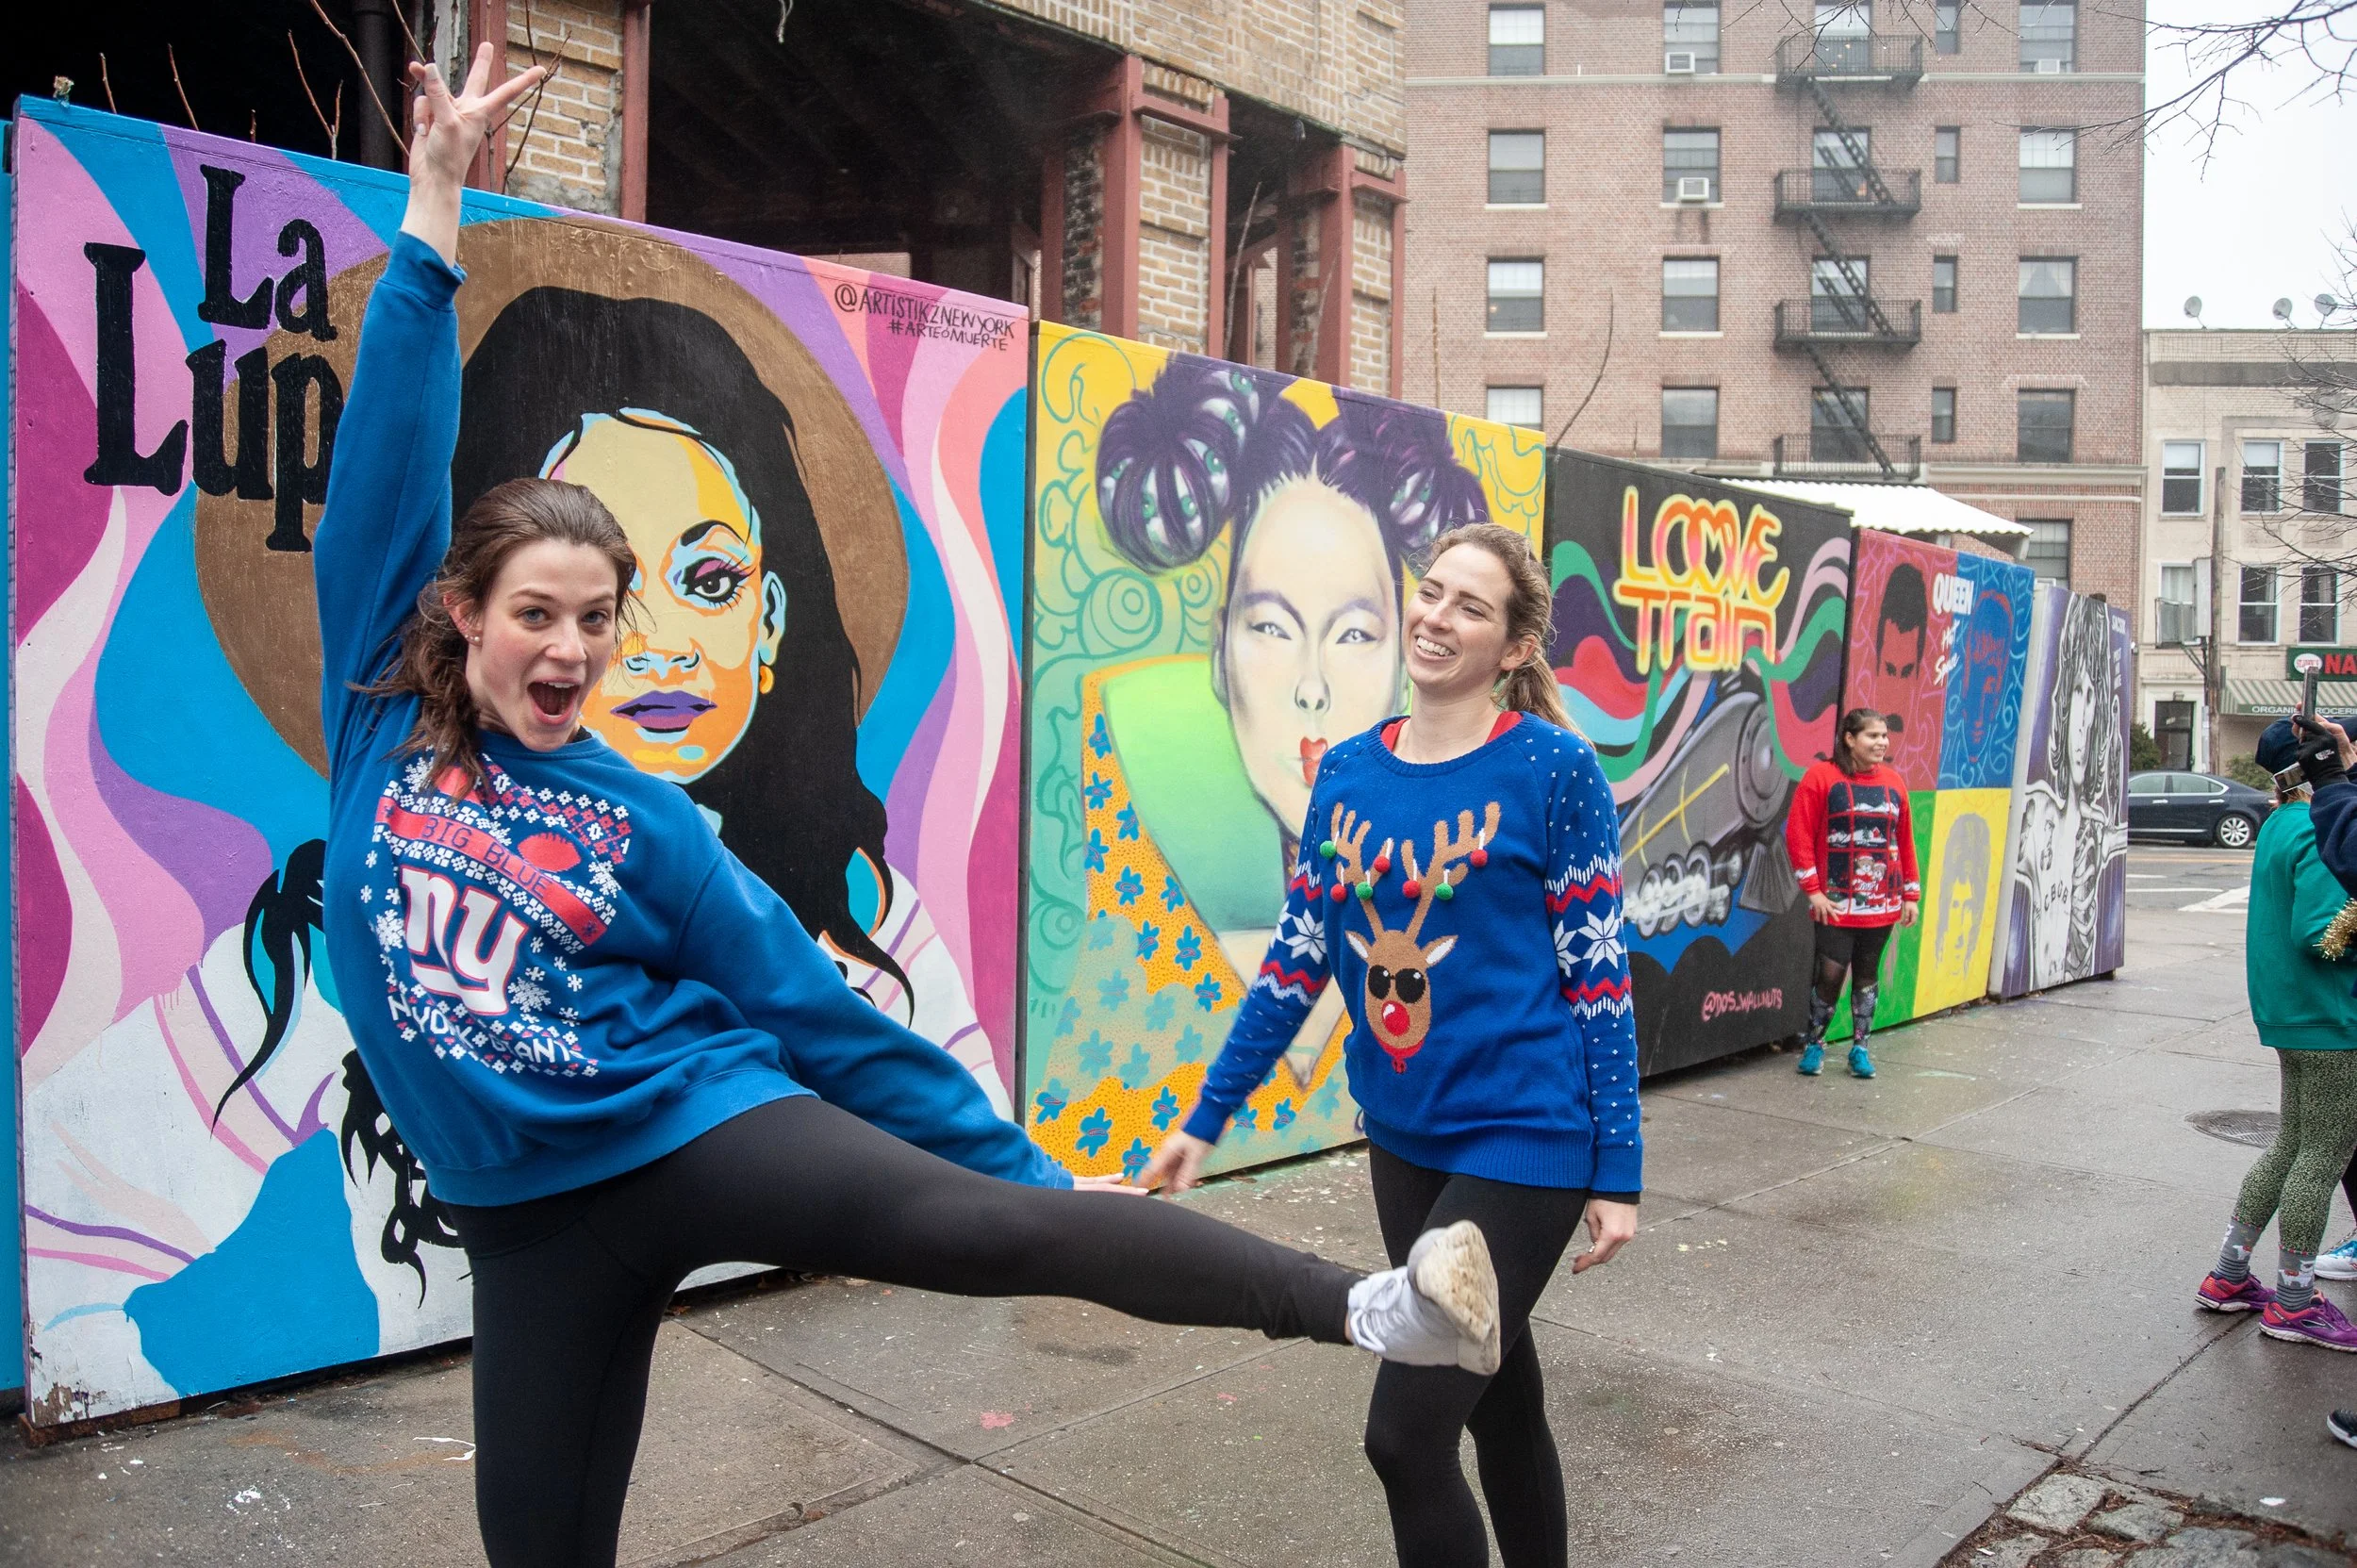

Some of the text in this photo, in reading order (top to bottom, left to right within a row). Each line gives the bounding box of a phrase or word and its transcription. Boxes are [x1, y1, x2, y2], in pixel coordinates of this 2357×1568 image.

[197, 164, 337, 342] La
[84, 242, 344, 553] Lup
[1933, 572, 1975, 615] QUEEN
[2324, 652, 2357, 675] NA
[2316, 707, 2357, 716] ROCERI
[421, 817, 553, 900] BIG BLUE
